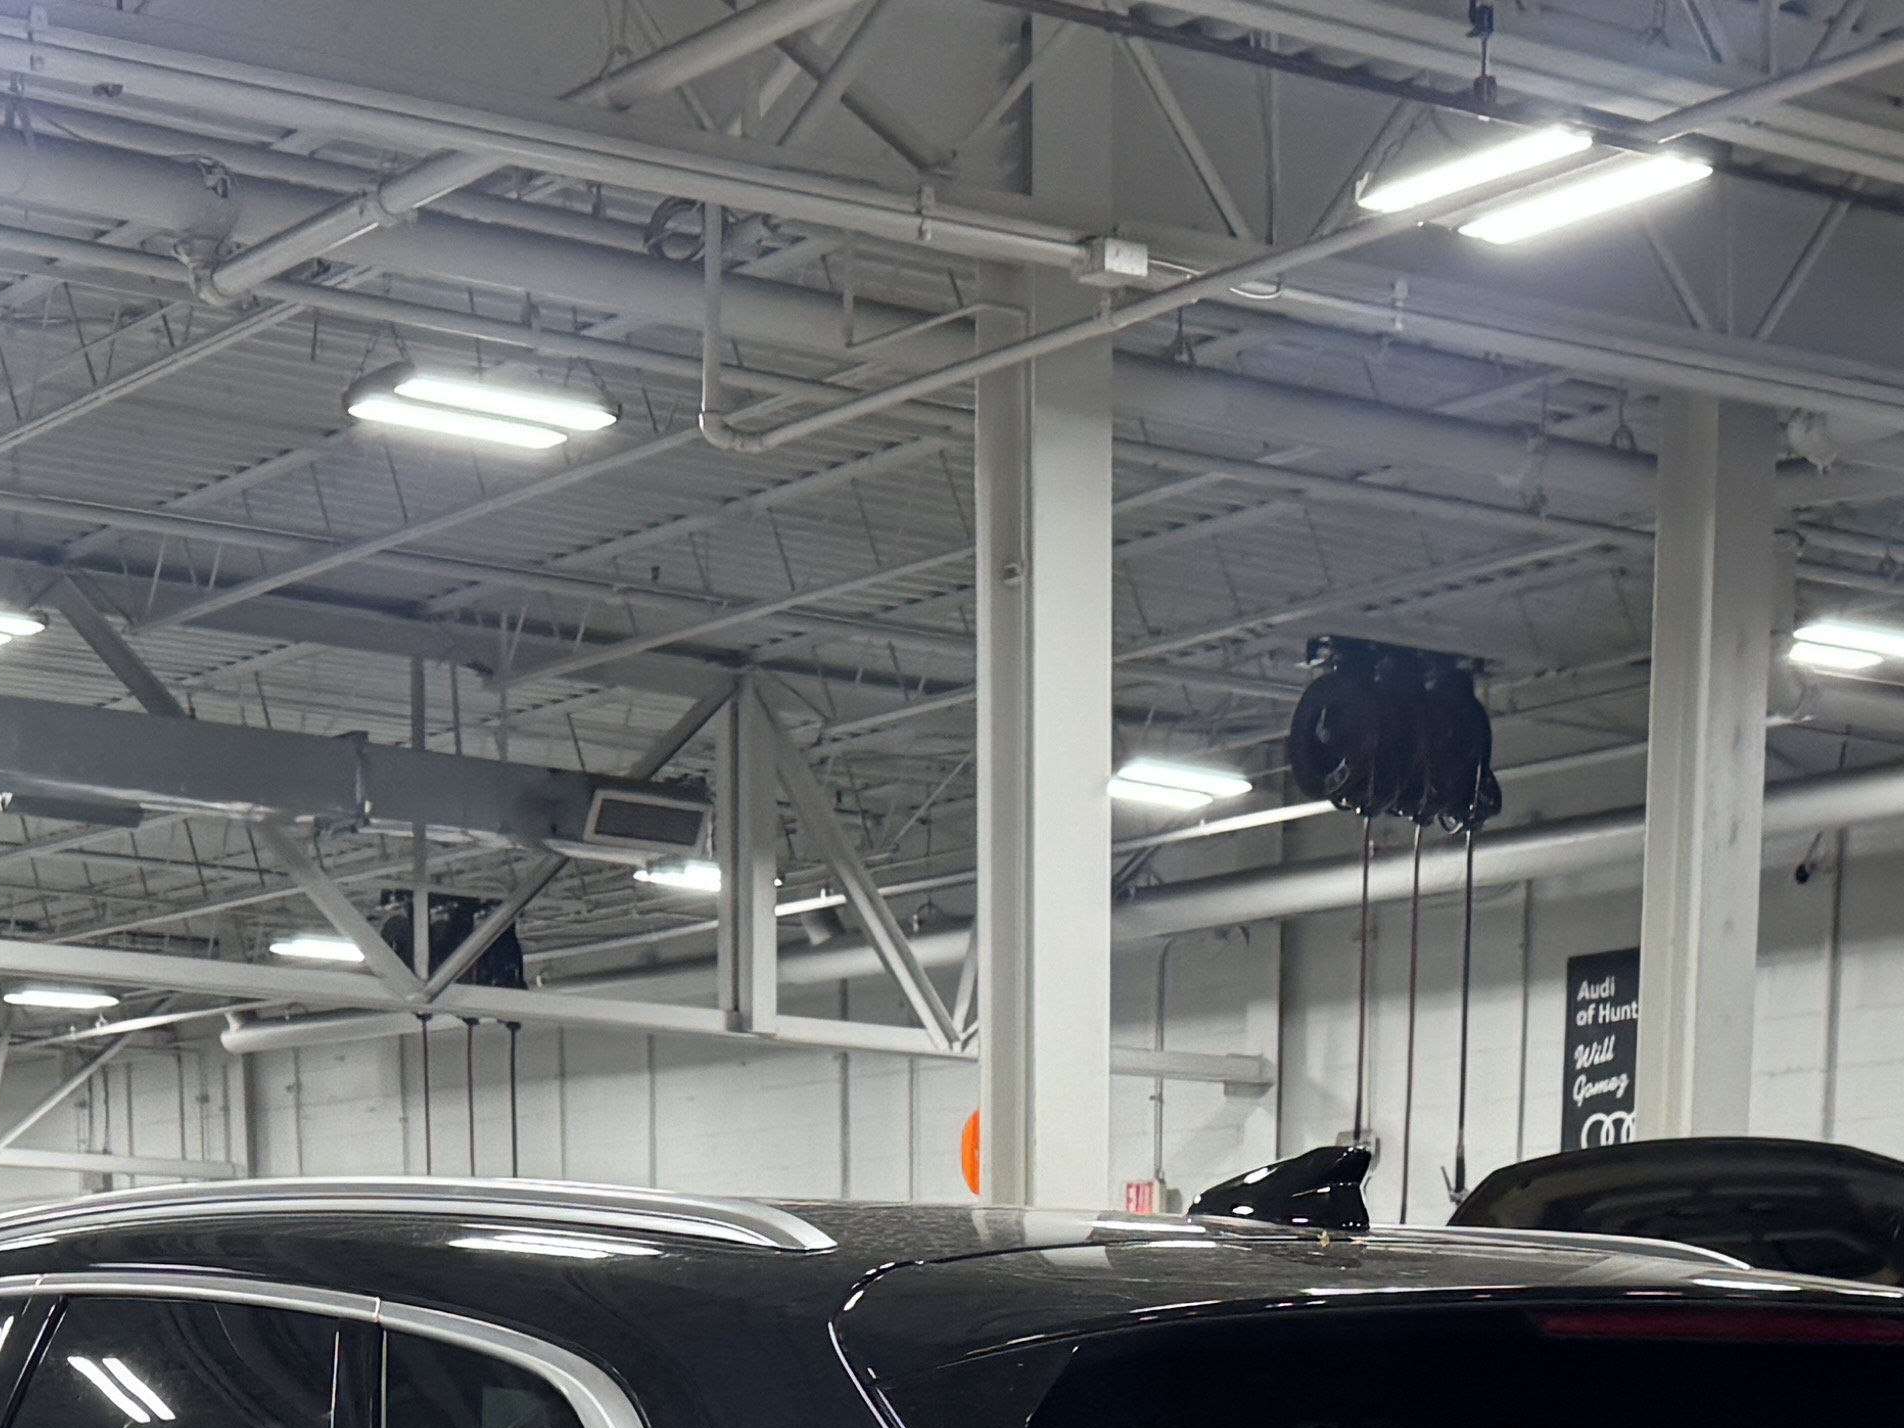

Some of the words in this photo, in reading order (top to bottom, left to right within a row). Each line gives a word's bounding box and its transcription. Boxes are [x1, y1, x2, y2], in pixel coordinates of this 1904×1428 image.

[1577, 976, 1616, 1002] Audi
[1576, 1004, 1596, 1026] of
[1574, 1034, 1616, 1070] Will
